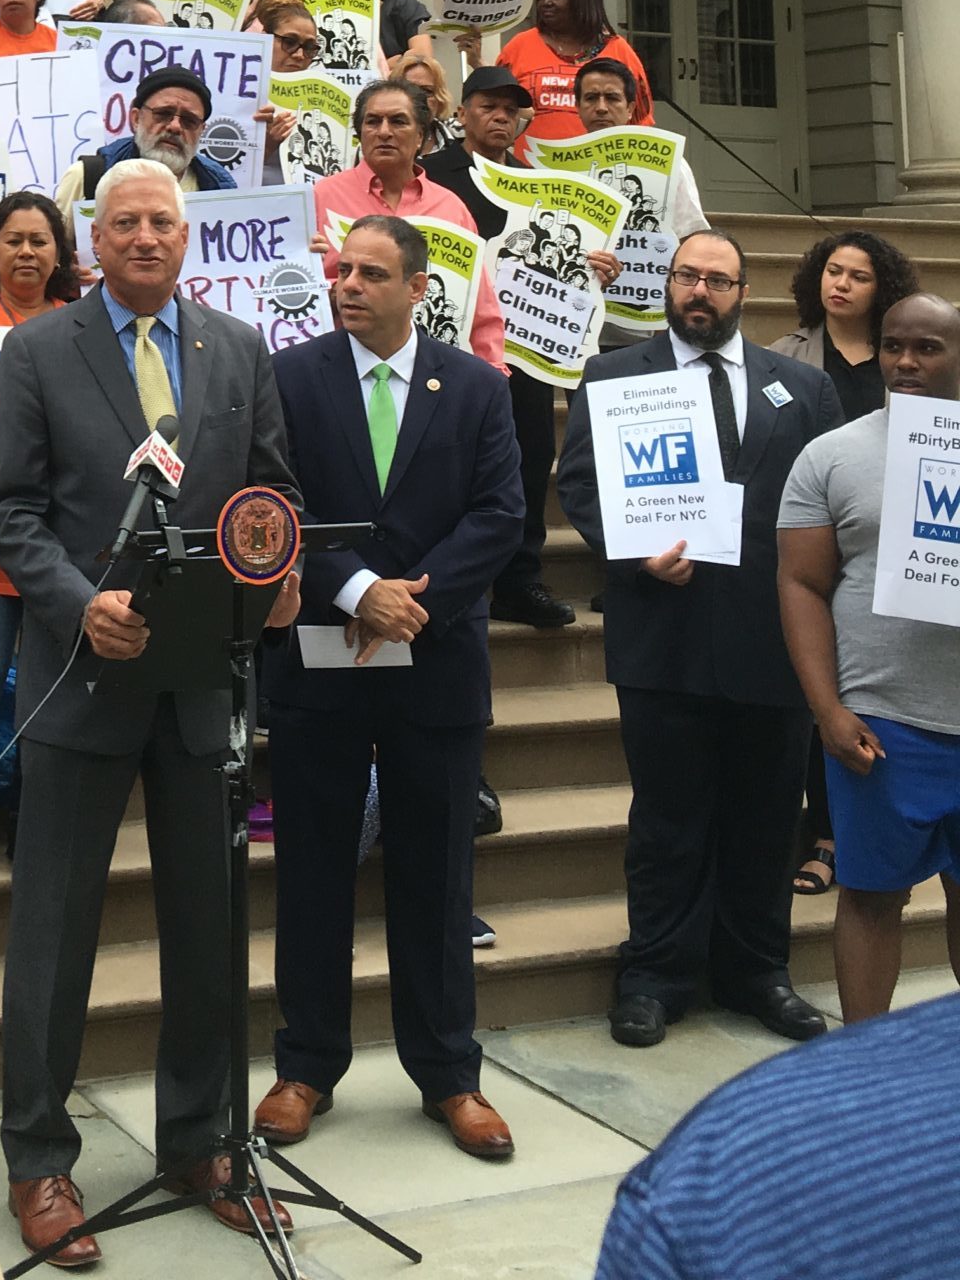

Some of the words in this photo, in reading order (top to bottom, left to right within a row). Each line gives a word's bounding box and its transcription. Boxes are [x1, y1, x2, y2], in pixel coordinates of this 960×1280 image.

[443, 5, 522, 24] Change!
[104, 39, 262, 99] CREATE
[541, 76, 570, 87] NEW
[271, 84, 301, 98] MAKE
[302, 83, 320, 95] THE
[321, 86, 350, 111] ROAD
[307, 96, 326, 108] NEW
[327, 102, 349, 121] YORK
[552, 147, 594, 162] MAKE
[594, 139, 624, 154] THE
[628, 138, 672, 157] ROAD
[605, 152, 634, 163] NEW
[635, 152, 668, 168] YORK
[496, 177, 539, 194] MAKE
[541, 183, 572, 196] THE
[575, 187, 617, 217] ROAD
[550, 196, 580, 211] NEW
[581, 203, 611, 228] YORK
[200, 216, 291, 265] MORE
[431, 233, 474, 259] ROAD
[615, 234, 648, 250] ght
[441, 250, 470, 272] YORK
[620, 260, 669, 276] mate
[177, 275, 265, 313] RTY
[253, 287, 280, 296] CLIMATE
[281, 285, 304, 293] WORKS
[512, 268, 569, 302] Fight
[603, 284, 663, 301] ange
[498, 289, 582, 334] Climate
[504, 318, 578, 360] hange!
[623, 385, 678, 400] Eliminate
[606, 398, 697, 418] #DirtyBuildings
[624, 423, 686, 436] WORKING
[624, 434, 689, 471] WF
[628, 472, 693, 484] FAMILIES
[625, 497, 635, 508] A
[638, 495, 675, 507] Green
[678, 494, 705, 504] New
[625, 513, 653, 524] Deal
[655, 511, 677, 522] For
[679, 509, 708, 521] NYC
[908, 549, 919, 561] A
[924, 552, 960, 568] Gree
[904, 568, 937, 580] Deal
[941, 575, 960, 587] Fo
